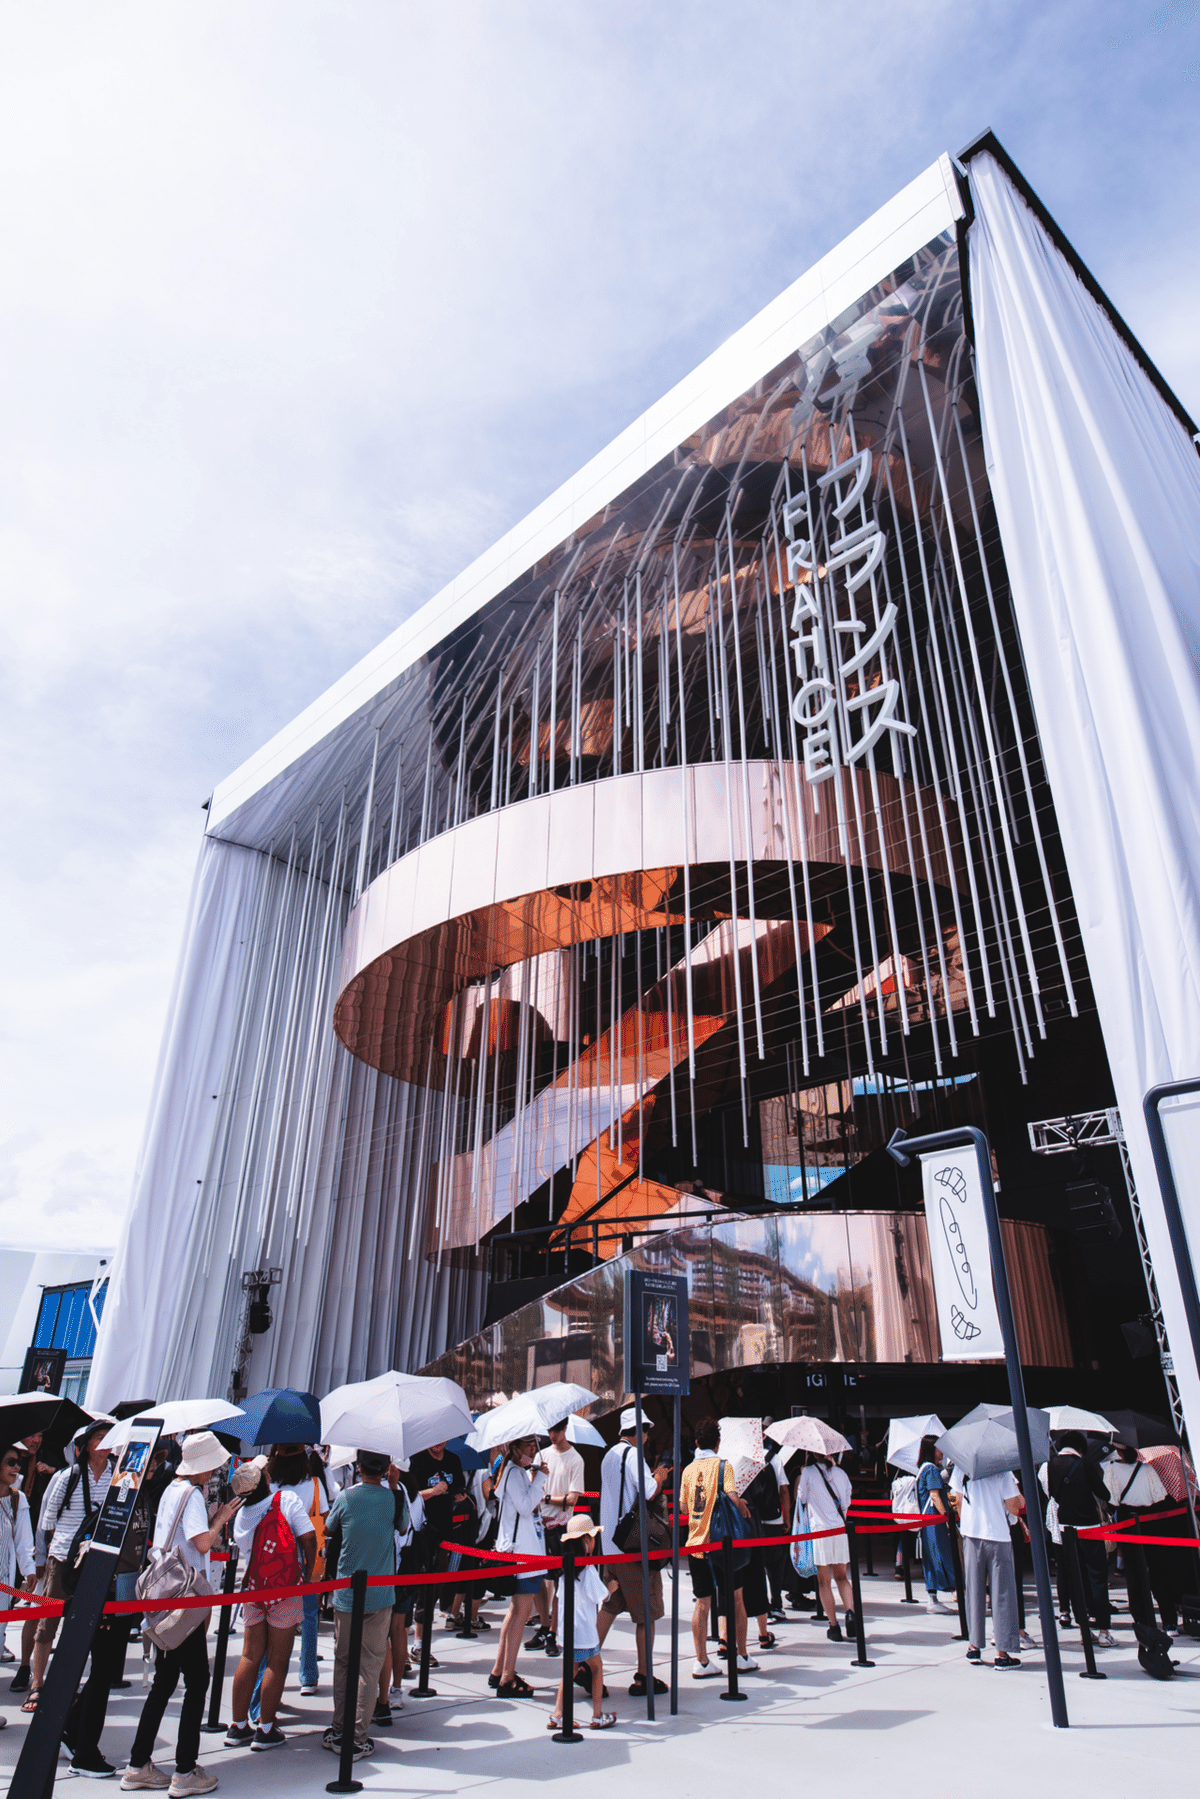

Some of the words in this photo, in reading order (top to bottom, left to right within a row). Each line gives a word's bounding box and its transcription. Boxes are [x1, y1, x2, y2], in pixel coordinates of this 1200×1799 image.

[783, 491, 836, 783] FRANCE
[817, 448, 918, 763] フランス
